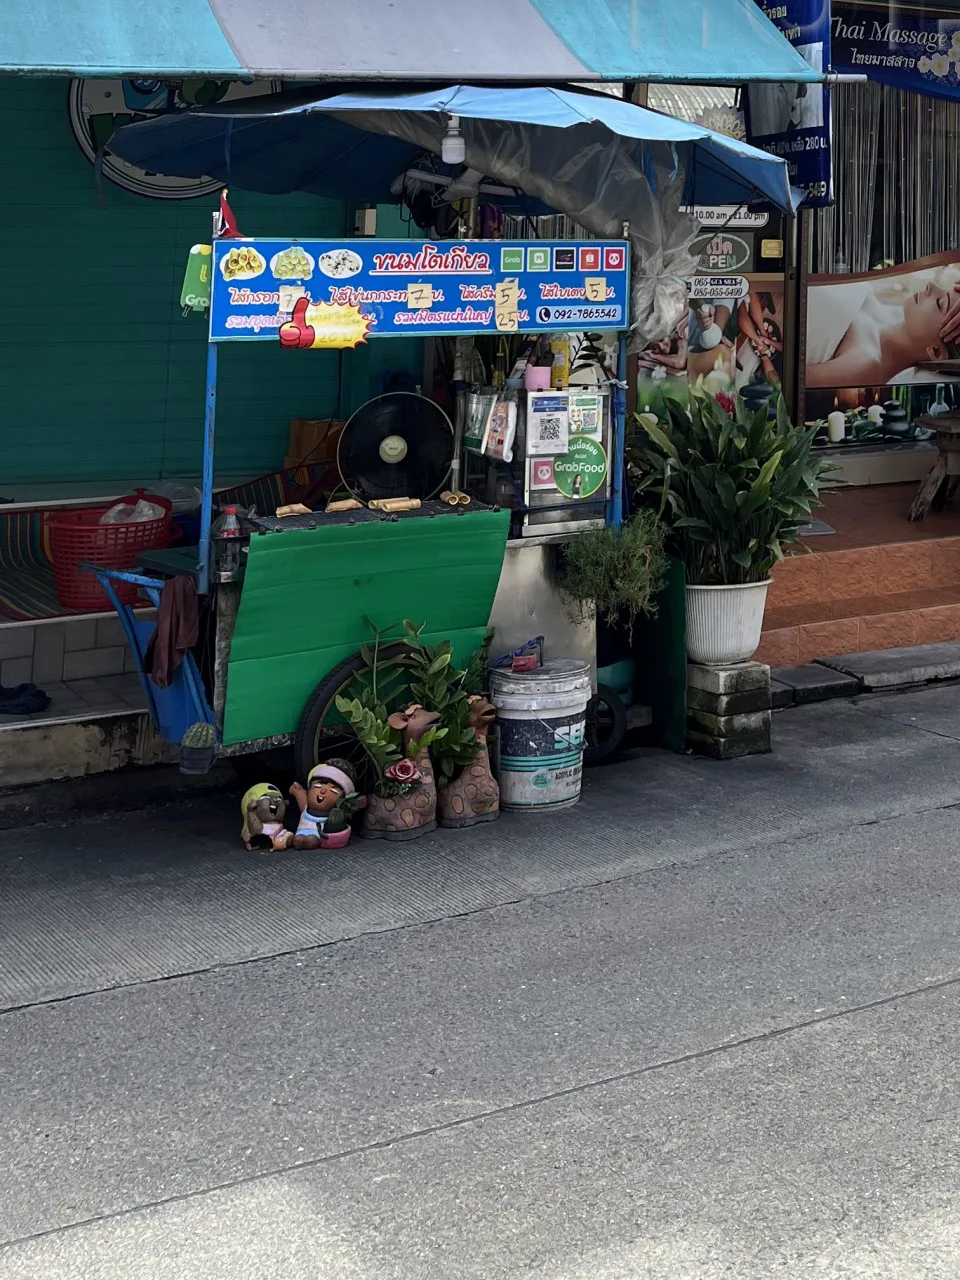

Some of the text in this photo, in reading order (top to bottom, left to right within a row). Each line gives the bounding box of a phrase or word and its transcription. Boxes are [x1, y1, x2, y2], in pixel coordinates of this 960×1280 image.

[868, 20, 948, 53] Massage
[695, 210, 714, 220] 10.00
[706, 236, 733, 255] เปิด
[374, 243, 491, 271] ขนมโตเกียว
[699, 254, 737, 267] OPEN
[460, 284, 497, 301] ไส้ครีม
[499, 287, 513, 304] 5
[588, 284, 600, 299] 5
[185, 294, 210, 306] Gra
[498, 311, 517, 329] 25
[553, 308, 617, 320] 092-7865542
[554, 461, 605, 474] GrabFood
